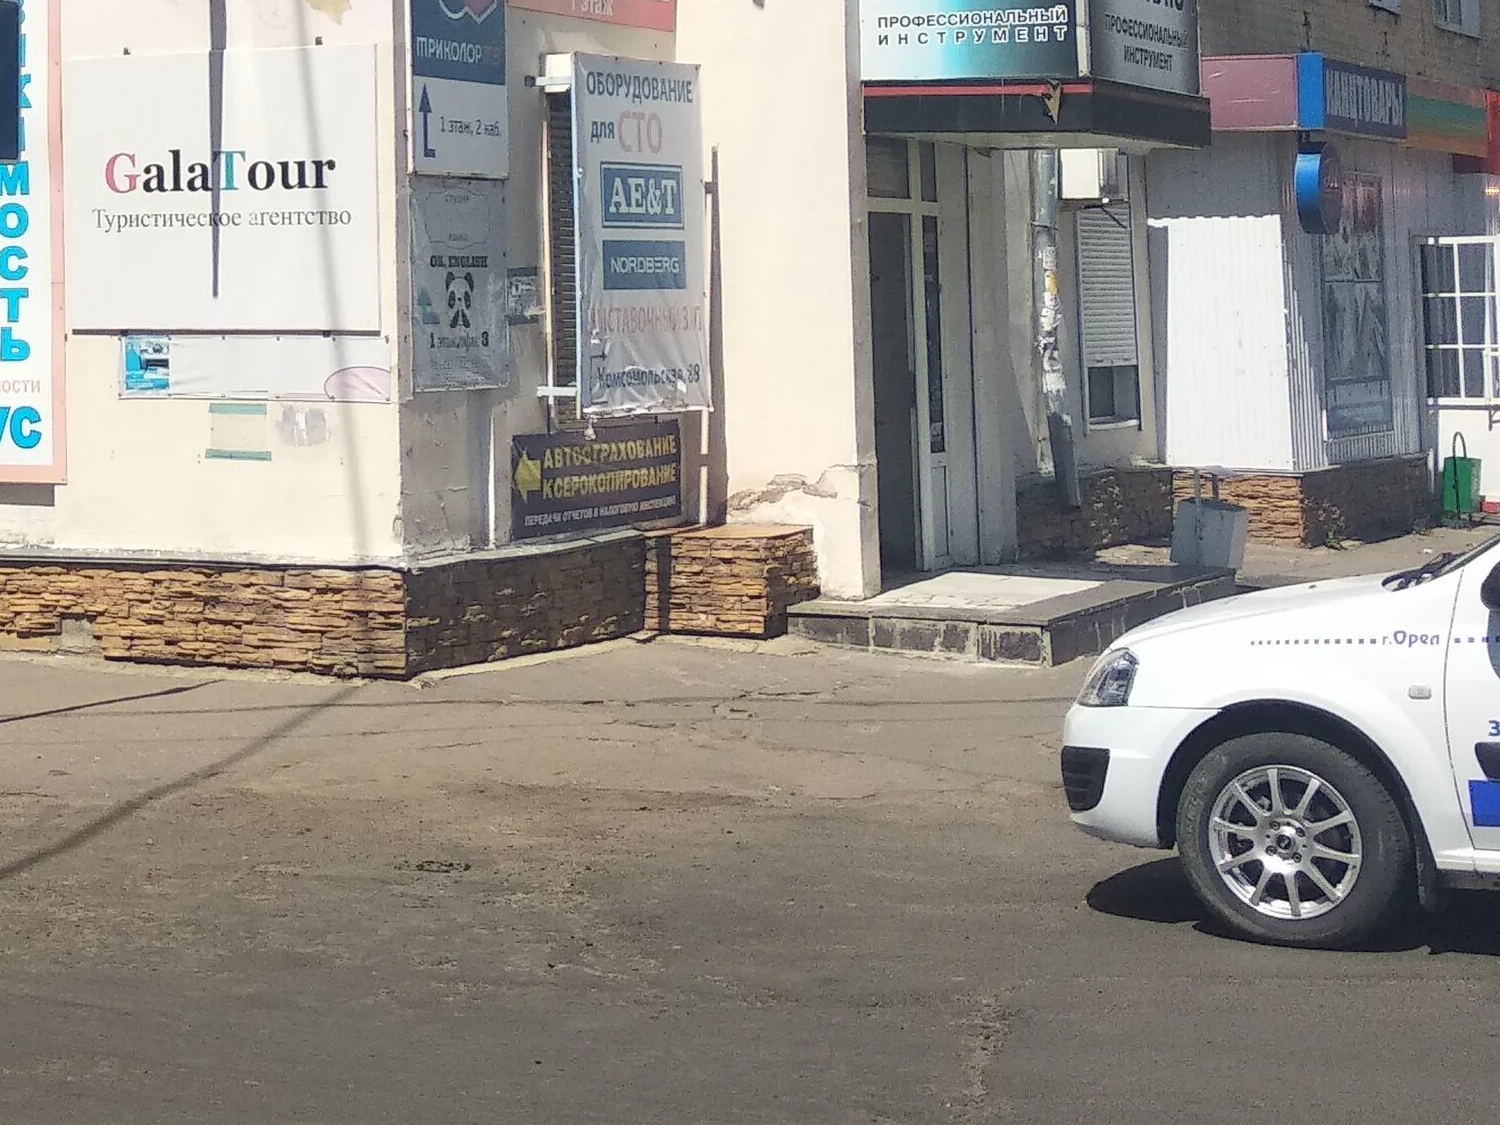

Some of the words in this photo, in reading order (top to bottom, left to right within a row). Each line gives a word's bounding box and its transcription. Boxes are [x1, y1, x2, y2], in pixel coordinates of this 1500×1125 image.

[878, 6, 1067, 28] ПРОФЕССИОНАЛЬНЫЙ
[1104, 13, 1188, 49] ПРОФЕССИОНАЛЬНЫЙ
[878, 27, 1067, 46] ИНСТРУМЕНТ
[1124, 44, 1173, 72] ИНСТРУМЕНТ
[586, 71, 693, 104] ОБОРУДОВАНИЕ
[440, 116, 445, 133] 1
[475, 119, 481, 134] 2
[590, 120, 615, 143] для
[618, 110, 663, 154] СТО
[105, 150, 335, 194] GalaTour
[609, 177, 677, 215] AE&T
[92, 208, 241, 233] Туристическое
[248, 208, 352, 228] агентство
[448, 255, 489, 268] ENGLISH
[610, 257, 680, 274] NORDBERG
[481, 331, 489, 347] 3
[543, 435, 677, 469] АВТОСТРАХОВАНИЕ
[543, 462, 677, 500] КСЕРОКОПИРОВАНИЕ
